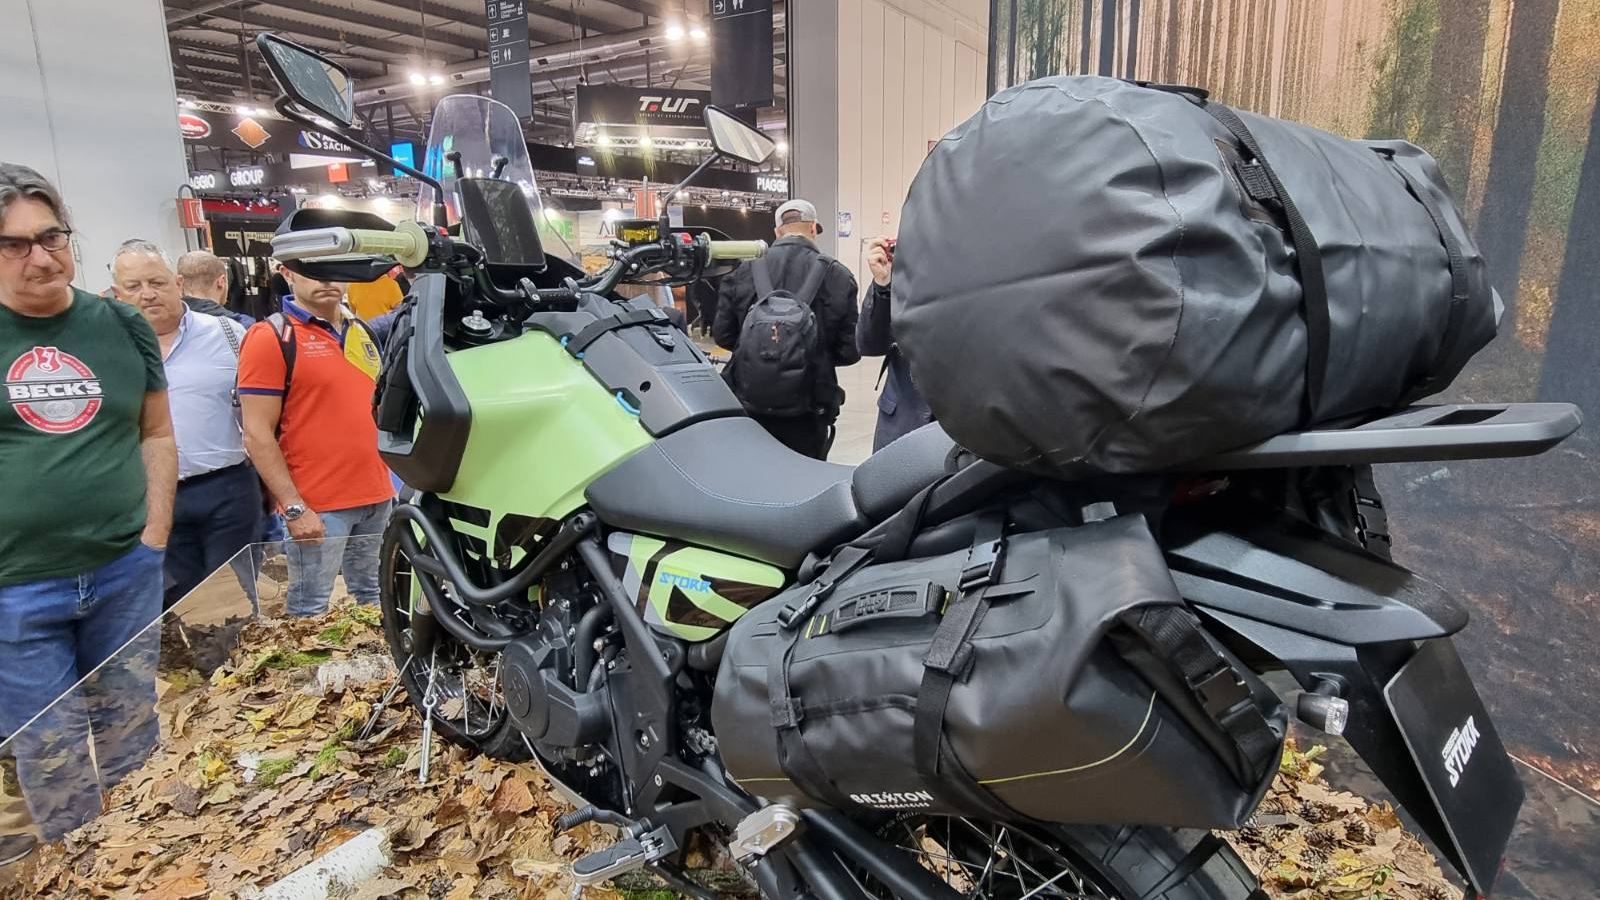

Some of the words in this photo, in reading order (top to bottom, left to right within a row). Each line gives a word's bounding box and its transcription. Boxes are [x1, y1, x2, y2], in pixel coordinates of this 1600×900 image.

[230, 169, 264, 186] GROUP
[8, 380, 102, 400] BECK'S
[850, 790, 934, 804] BRIXTON
